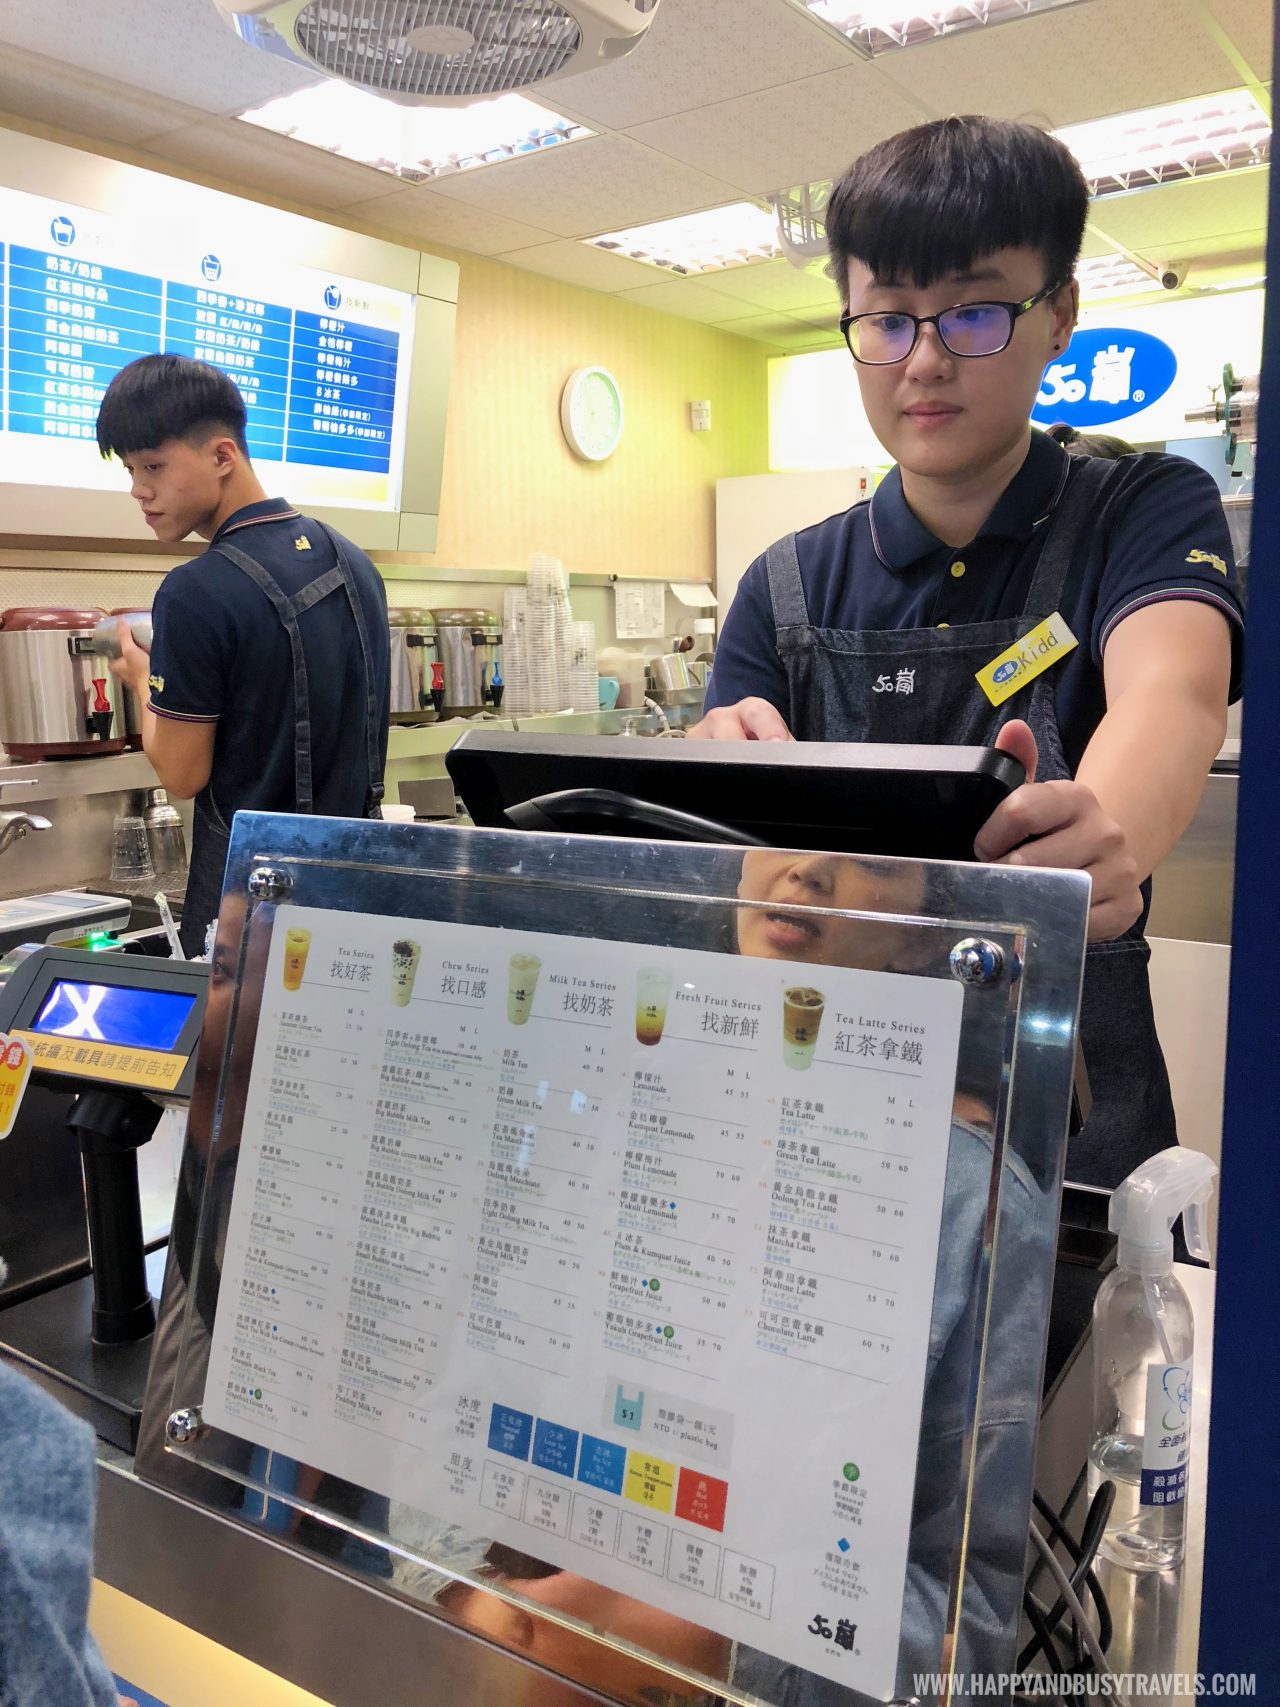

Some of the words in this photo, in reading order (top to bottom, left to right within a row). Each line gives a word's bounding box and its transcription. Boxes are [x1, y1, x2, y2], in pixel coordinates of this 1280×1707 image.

[1017, 631, 1058, 669] Kidd
[338, 947, 351, 956] Tea
[352, 949, 375, 959] Series
[331, 960, 373, 982] 找好茶
[443, 960, 464, 972] Chew
[466, 963, 490, 974] Series
[442, 975, 488, 999] 找口感
[549, 974, 568, 985] Milk
[572, 977, 587, 987] Tea
[590, 980, 616, 991] Series
[563, 992, 615, 1016] 找奶茶
[675, 991, 701, 1003] Fresh
[704, 995, 728, 1006] Fruit
[731, 999, 761, 1011] Series
[702, 1011, 759, 1039] 找新鮮
[835, 1013, 854, 1025] Tea
[859, 1016, 886, 1030] Latte
[891, 1021, 926, 1035] Series
[834, 1031, 923, 1066] 紅茶拿鐵
[502, 1058, 517, 1067] Milk
[517, 1060, 528, 1069] Tea
[633, 1080, 667, 1093] Lemonade
[515, 1098, 529, 1108] Milk
[532, 1102, 542, 1110] Tea
[888, 1096, 896, 1104] M
[781, 1107, 795, 1118] Tea
[797, 1110, 816, 1121] Latte
[886, 1117, 895, 1125] 50
[903, 1120, 913, 1128] 60
[628, 1120, 658, 1135] Kumquat
[660, 1126, 695, 1140] Lemonade
[720, 1129, 729, 1137] 45
[776, 1150, 798, 1161] Green
[801, 1153, 814, 1164] Tea
[817, 1157, 836, 1168] Latte
[881, 1161, 890, 1169] 50
[624, 1160, 640, 1171] Plum
[643, 1163, 677, 1178] Lemonade
[732, 1174, 740, 1182] 60
[619, 1201, 641, 1212] Yakult
[643, 1206, 678, 1220] Lemonade
[771, 1192, 798, 1206] Oolong
[801, 1197, 815, 1208] Tea
[817, 1201, 837, 1213] Latte
[876, 1205, 886, 1213] 50
[894, 1209, 904, 1217] 60
[482, 1208, 498, 1219] Light
[522, 1216, 536, 1227] Milk
[539, 1220, 549, 1231] Tea
[767, 1235, 794, 1248] Matcha
[796, 1242, 816, 1253] Latte
[615, 1241, 631, 1251] Plum
[641, 1248, 672, 1263] Kumquat
[673, 1256, 692, 1266] Juice
[706, 1254, 715, 1262] 40
[889, 1254, 899, 1262] 60
[609, 1282, 643, 1297] Grapefruit
[645, 1291, 663, 1302] Juice
[762, 1278, 794, 1294] Ovaltine
[796, 1287, 816, 1298] Latte
[717, 1301, 726, 1309] 60
[605, 1321, 627, 1334] Yakult
[628, 1330, 663, 1345] Grapefruit
[665, 1339, 683, 1351] Juice
[757, 1320, 794, 1338] Chocolate
[796, 1332, 817, 1344] Latte
[862, 1339, 872, 1347] 60
[880, 1343, 890, 1352] 75
[654, 1422, 670, 1433] NTD
